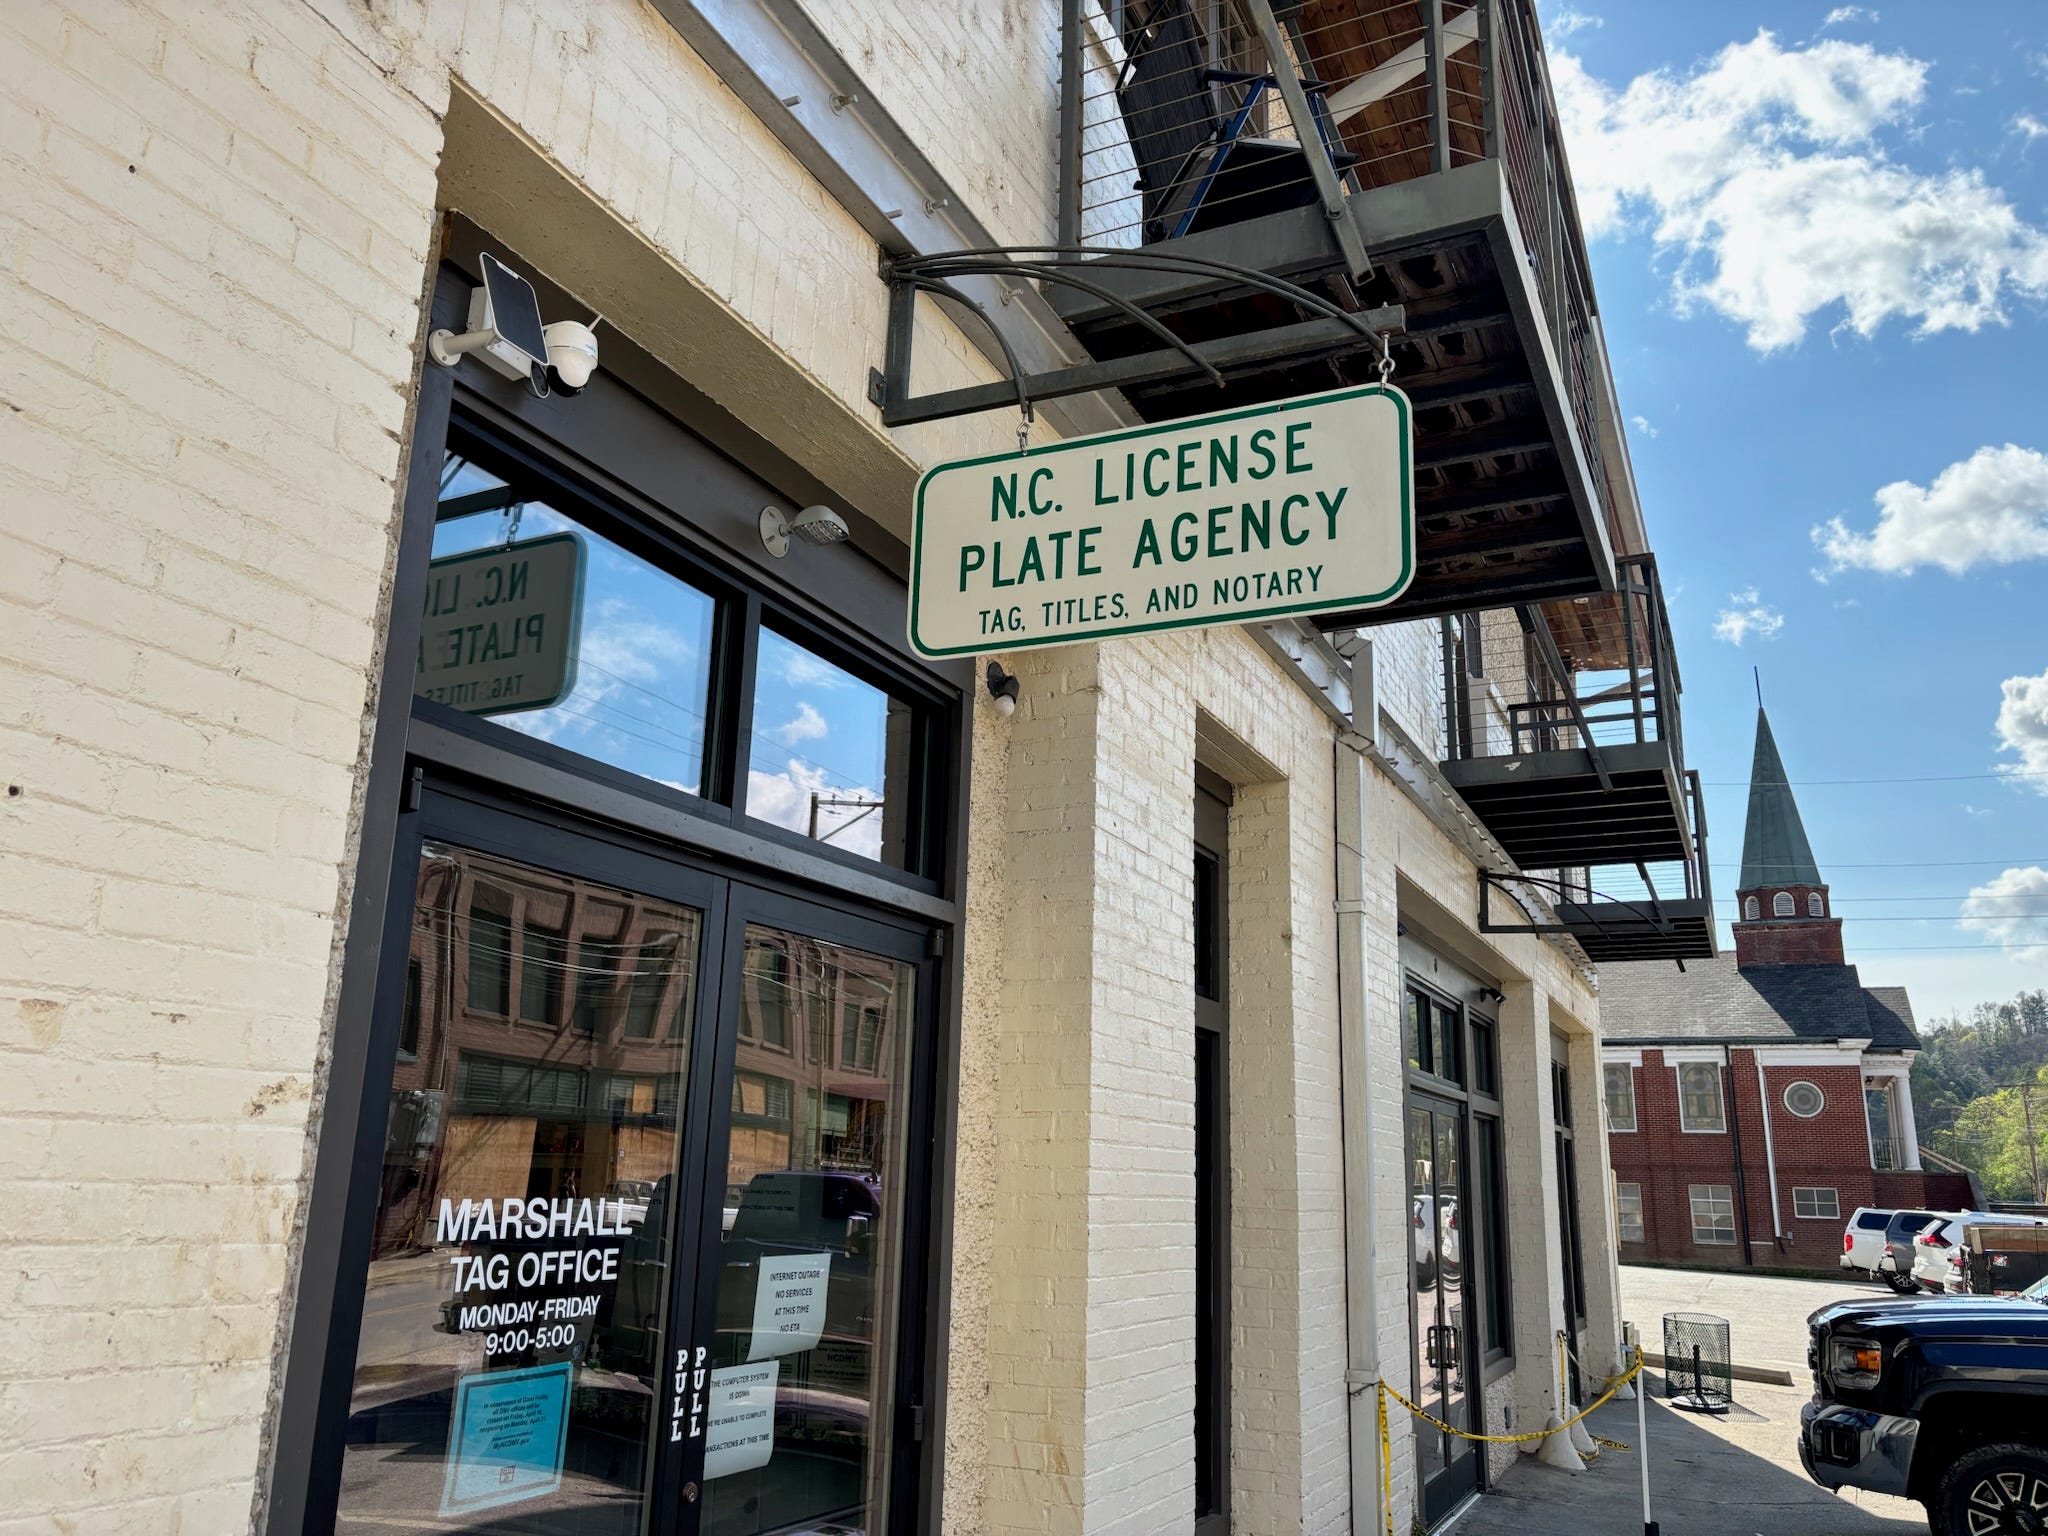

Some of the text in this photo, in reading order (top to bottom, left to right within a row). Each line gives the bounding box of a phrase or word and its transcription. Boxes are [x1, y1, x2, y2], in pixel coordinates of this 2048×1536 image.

[990, 421, 1313, 522] N.C. LICENSE
[959, 487, 1348, 592] PLATE AGENCY
[979, 565, 1324, 635] TAG, TITLES, AND NOTARY
[436, 1197, 633, 1242] MARSHALL
[450, 1248, 620, 1293] TAG OFFICE
[769, 1270, 820, 1281] INTERNET OUTAGE
[775, 1287, 813, 1298] NO SERVICES
[459, 1295, 601, 1330] MONDAY-FRIDAY
[774, 1304, 809, 1316] AT THIS TIME
[486, 1324, 575, 1356] 9:00-5:00
[779, 1323, 800, 1332] NO ETA
[670, 1349, 688, 1442] PULL
[689, 1346, 707, 1438] PULL
[711, 1372, 769, 1388] THE COMPUTER SYSTEM
[729, 1389, 750, 1400] IS DOWN
[721, 1415, 738, 1425] UNABLE
[745, 1410, 767, 1420] COMPLETE
[739, 1437, 746, 1446] AT
[746, 1435, 758, 1444] THIS
[759, 1433, 770, 1442] TIME
